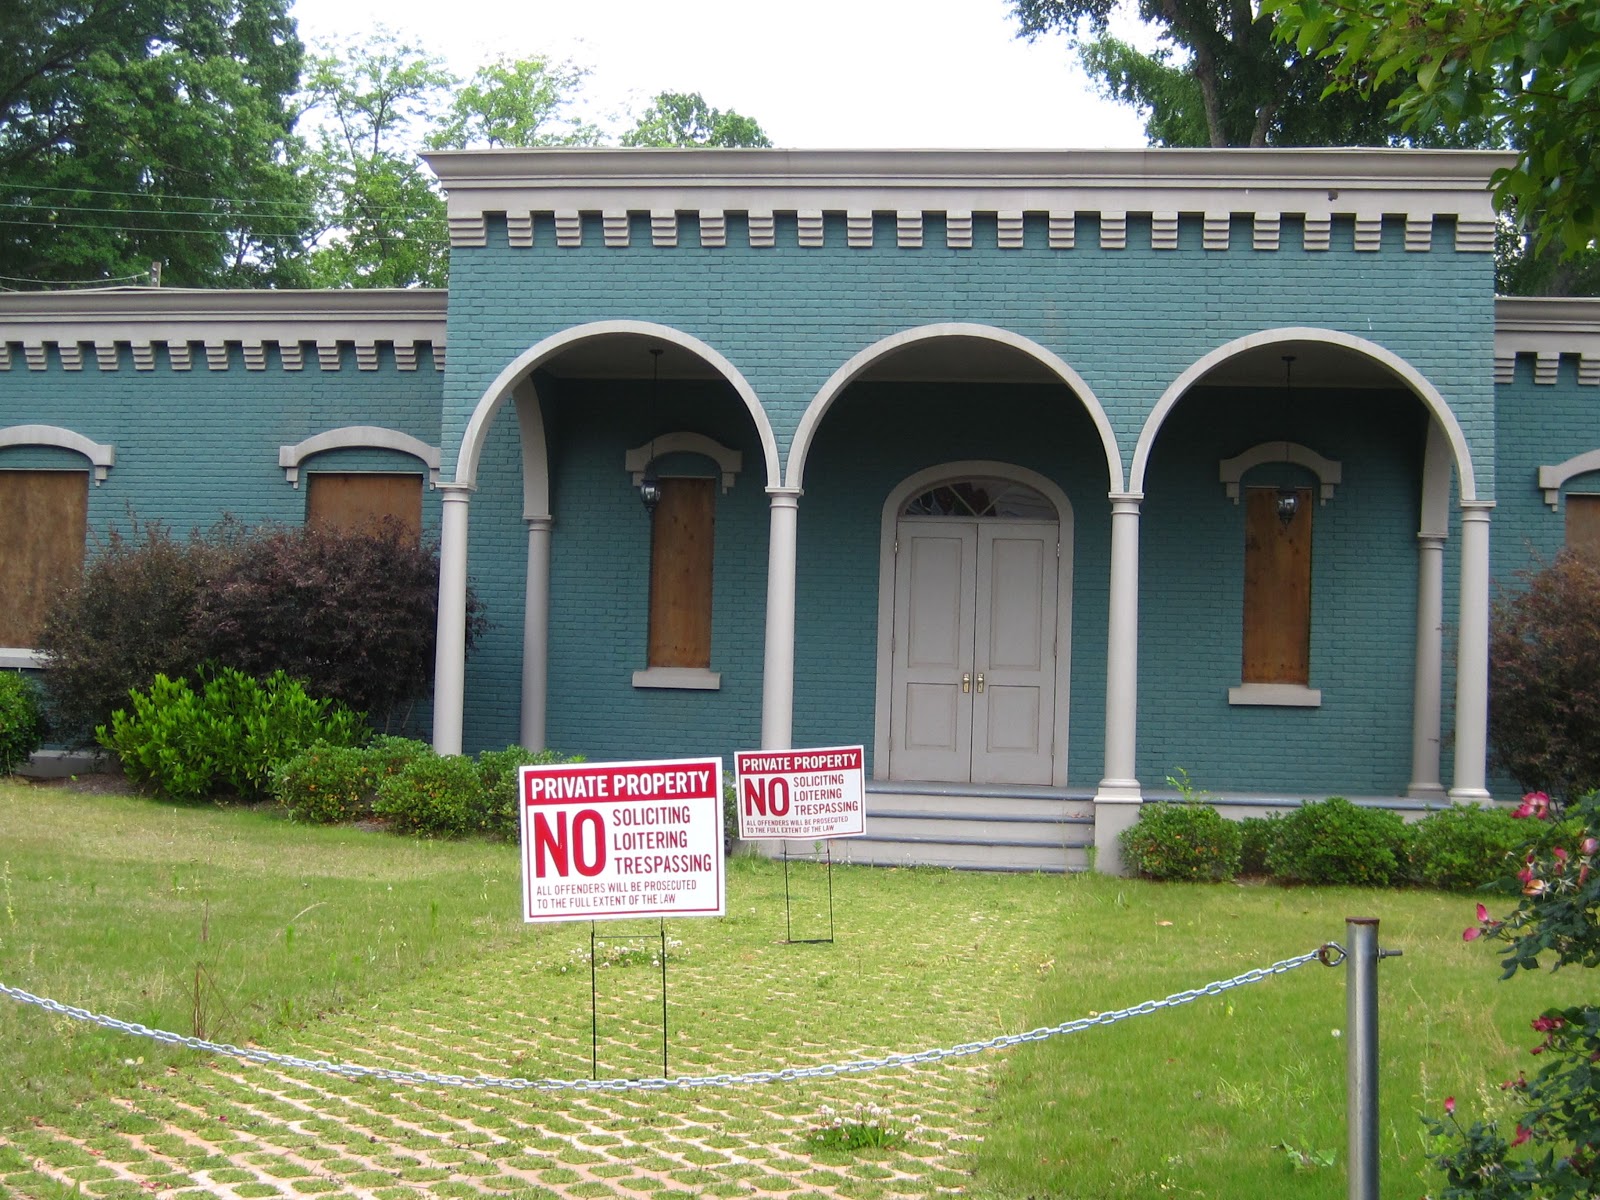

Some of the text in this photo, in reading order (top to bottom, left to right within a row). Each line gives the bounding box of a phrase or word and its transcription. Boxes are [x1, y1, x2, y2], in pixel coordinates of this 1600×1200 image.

[794, 753, 857, 769] PROPERTY
[531, 770, 710, 800] PRIVATE PROPERTY
[744, 777, 790, 816] NO
[612, 806, 690, 826] SOLICITING
[794, 801, 858, 815] TRESPASSING
[534, 809, 606, 878] NO
[614, 831, 687, 850] LOITERING
[614, 854, 711, 874] TRESPASSING
[537, 880, 696, 895] ALL OFFENDERS WILL BE PROSECUTED
[537, 899, 548, 909] TO
[551, 898, 566, 908] THE
[570, 897, 591, 908] FULL
[593, 894, 625, 906] EXTENT
[629, 894, 639, 905] OF
[642, 894, 658, 904] THE
